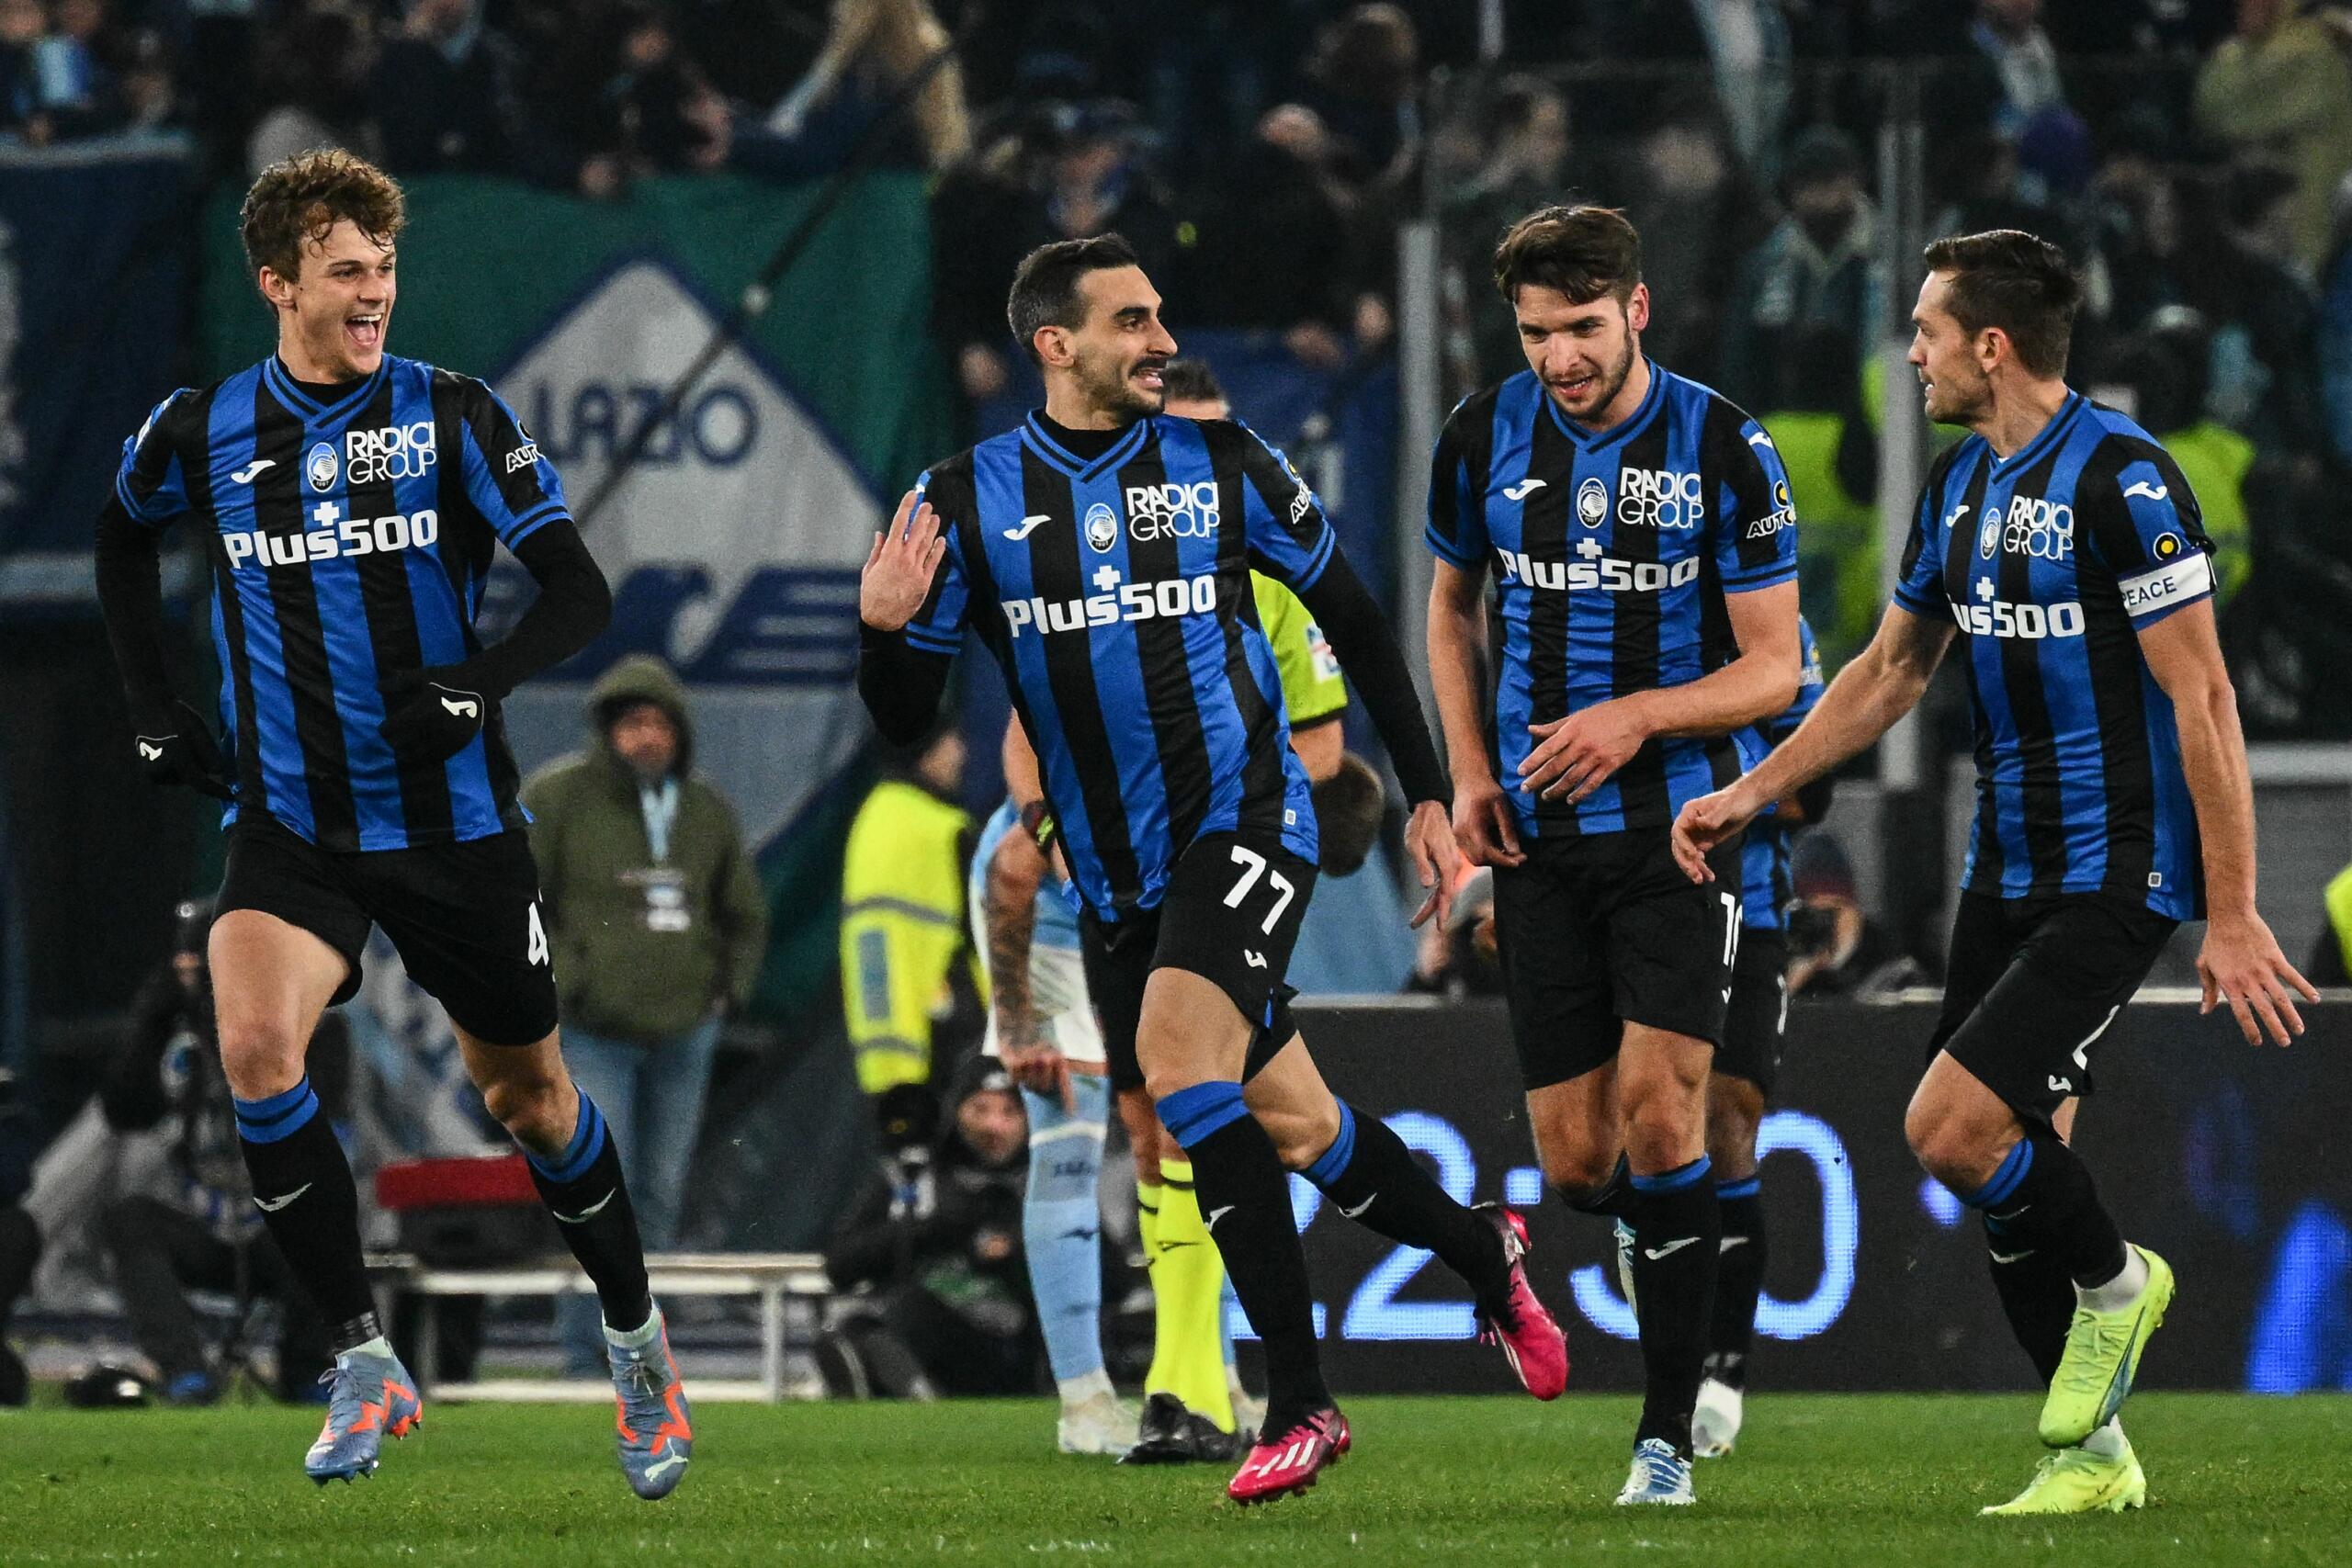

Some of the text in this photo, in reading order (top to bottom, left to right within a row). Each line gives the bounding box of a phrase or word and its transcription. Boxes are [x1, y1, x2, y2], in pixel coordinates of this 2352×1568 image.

[346, 422, 435, 459] RADICI
[346, 448, 437, 485] GROUP
[1620, 467, 1702, 503] RADICI
[1125, 482, 1219, 516] RADICI
[1617, 496, 1705, 530] GROUP
[2007, 495, 2075, 536] RADICI
[223, 509, 439, 570] Plus500
[1129, 510, 1221, 542] GROUP
[2003, 524, 2075, 561] GROUP
[1498, 547, 1702, 592] Plus500
[1001, 574, 1217, 638] Plus500
[1946, 592, 2086, 639] us500
[1223, 845, 1295, 936] 77
